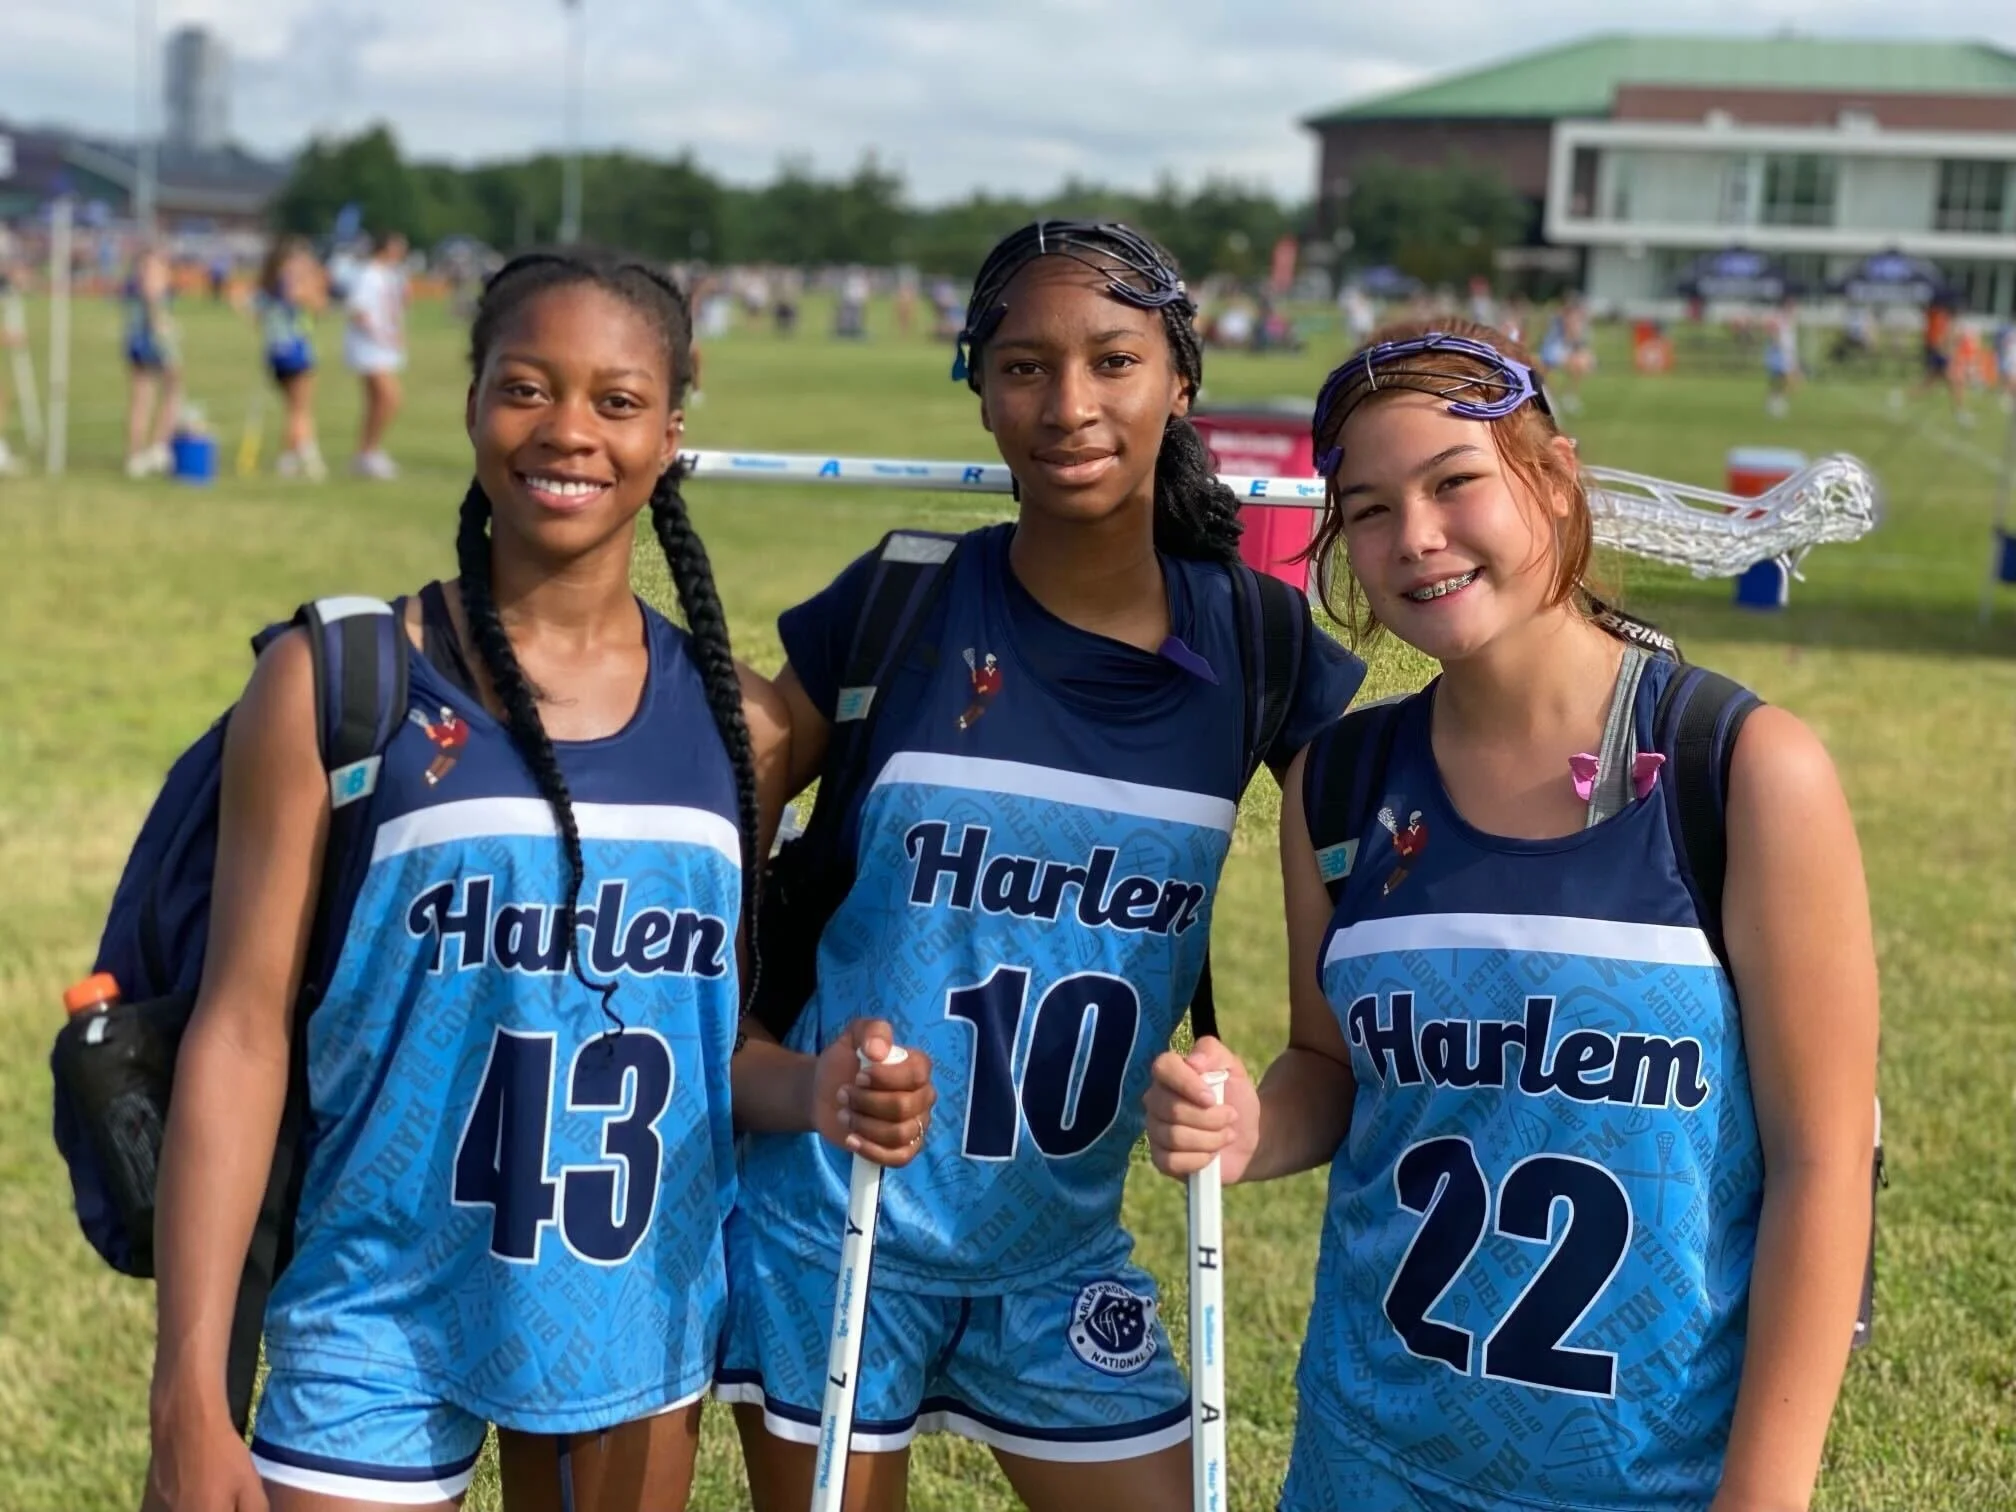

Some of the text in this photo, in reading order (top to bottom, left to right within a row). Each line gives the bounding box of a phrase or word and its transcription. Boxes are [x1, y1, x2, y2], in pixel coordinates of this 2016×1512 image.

[819, 459, 841, 477] A
[962, 467, 984, 484] R
[1249, 479, 1270, 498] E
[943, 965, 1140, 1162] 10
[1348, 990, 1711, 1112] Harlem
[450, 1025, 677, 1266] 43
[1197, 1244, 1217, 1270] H
[1382, 1135, 1634, 1400] 22
[829, 1372, 847, 1389] L
[847, 1215, 864, 1237] Y
[1091, 1351, 1146, 1370] NATIONAL
[1200, 1400, 1220, 1425] A
